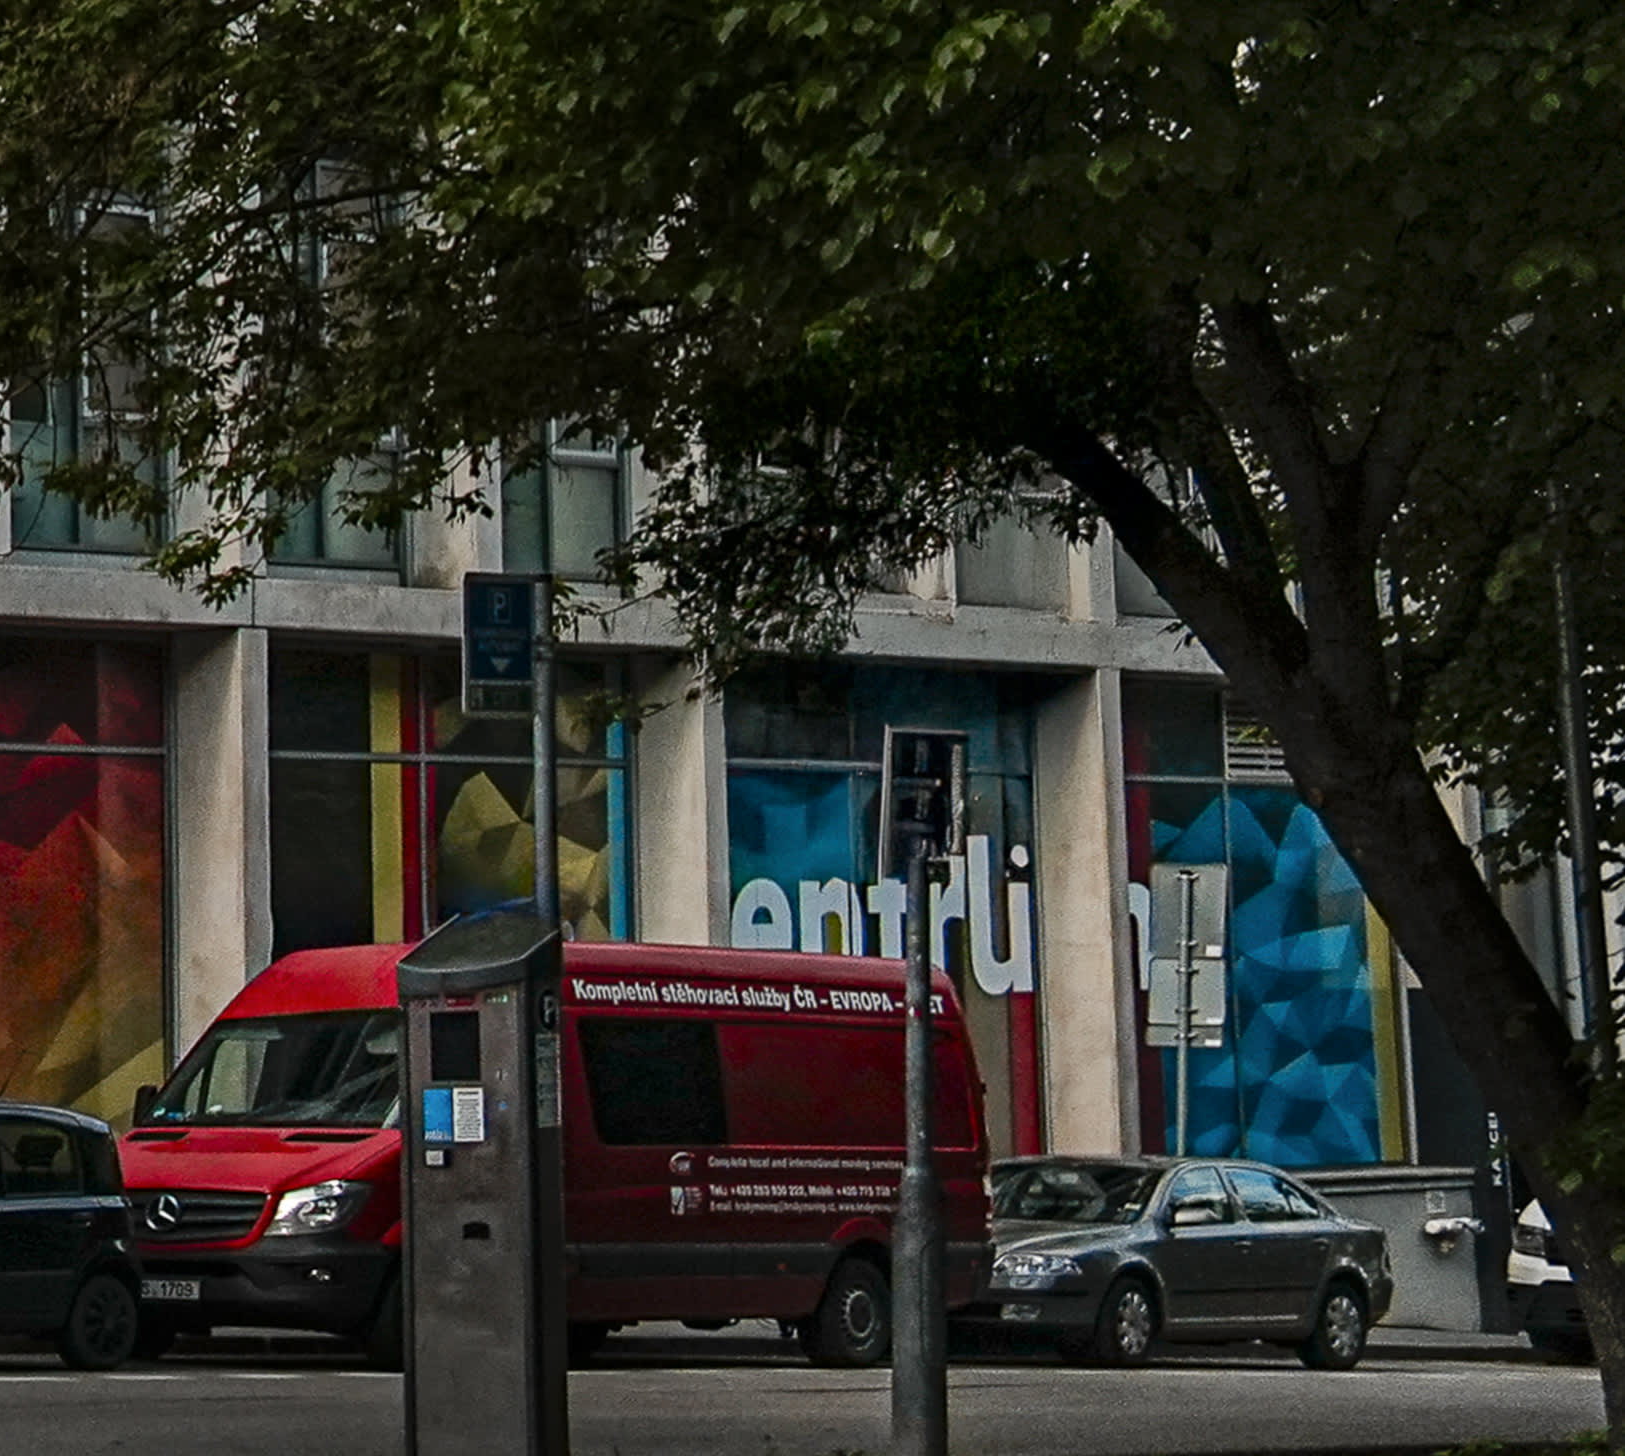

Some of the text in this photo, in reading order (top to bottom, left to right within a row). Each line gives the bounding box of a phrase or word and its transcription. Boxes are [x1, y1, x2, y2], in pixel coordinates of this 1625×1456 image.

[571, 978, 659, 1005] Kompletní
[661, 983, 739, 1006] stěhovací
[741, 986, 791, 1012] služby
[793, 984, 818, 1009] ČR
[831, 990, 894, 1013] EVROPA
[771, 1158, 786, 1168] and
[788, 1158, 840, 1169] international
